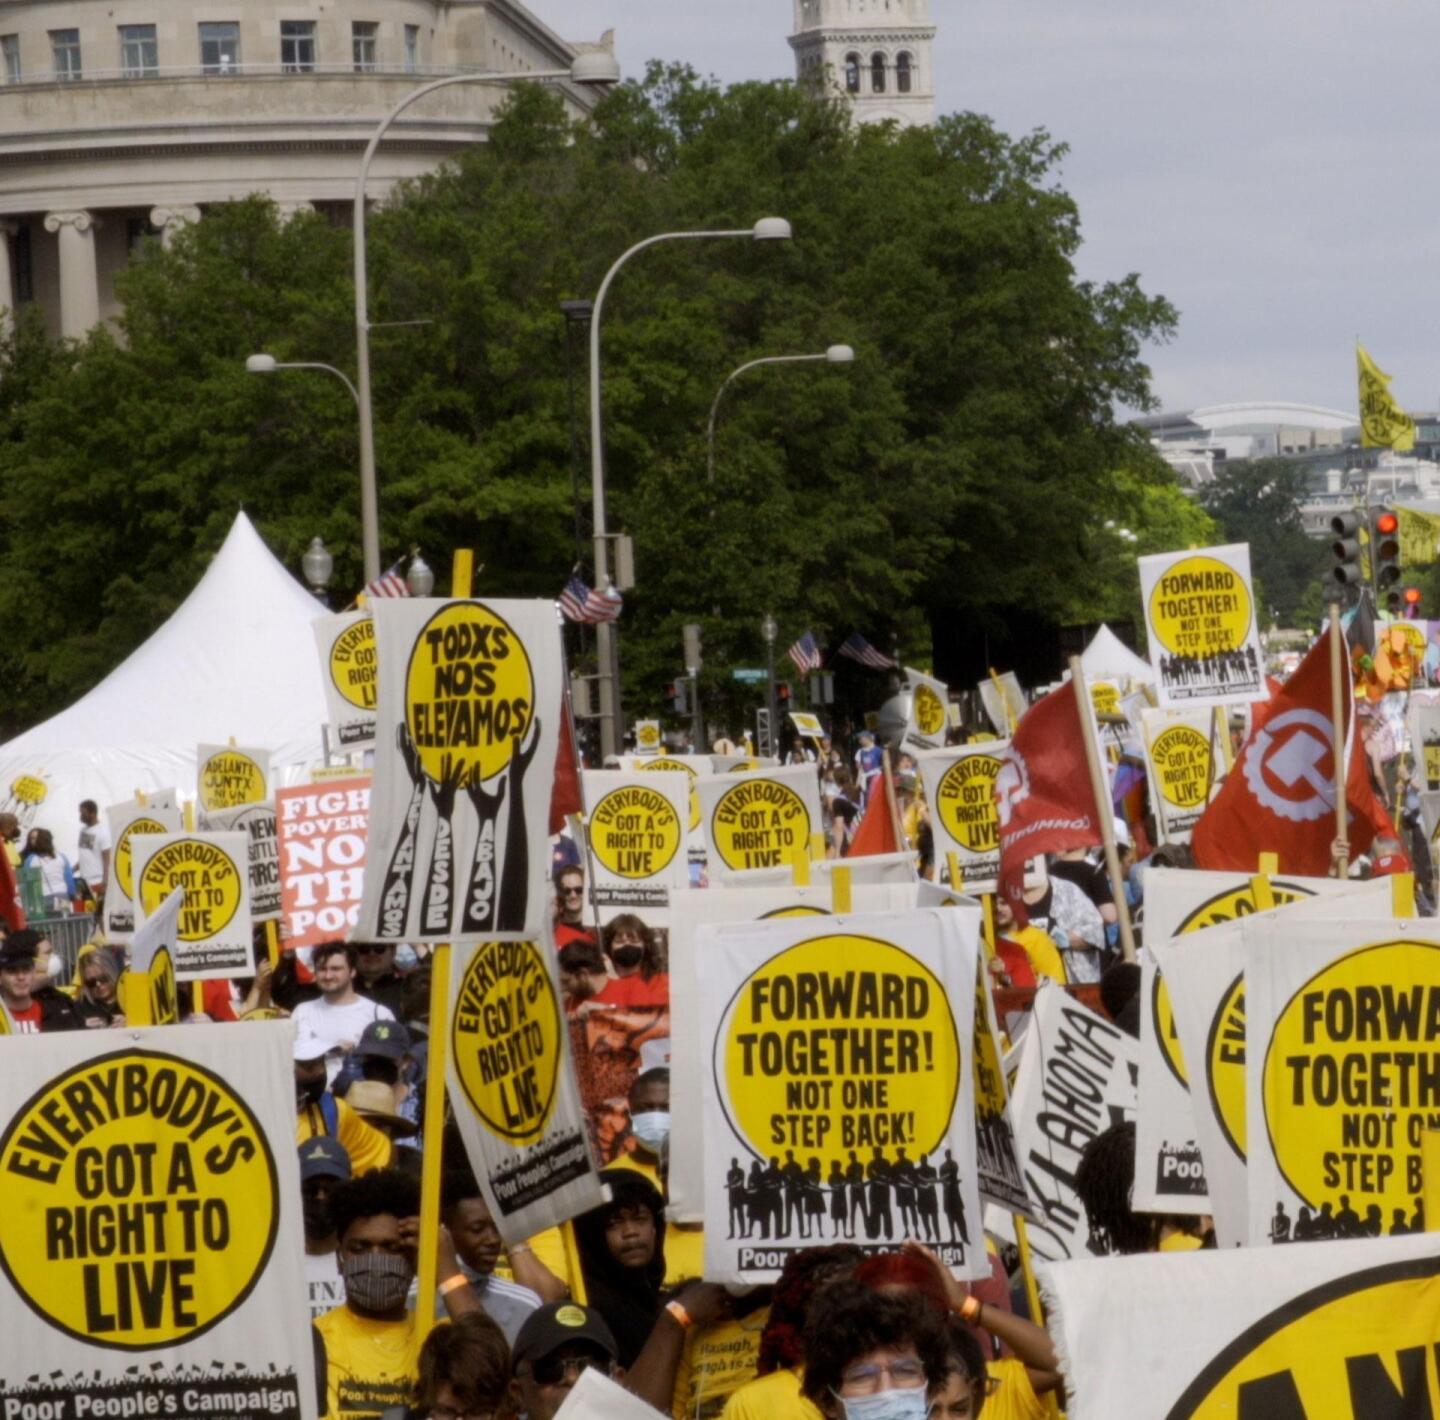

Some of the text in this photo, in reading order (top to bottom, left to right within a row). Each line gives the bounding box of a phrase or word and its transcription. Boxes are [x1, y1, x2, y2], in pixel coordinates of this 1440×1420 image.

[1162, 571, 1233, 596] FORWARD
[1159, 595, 1237, 618] TOGETHER!
[1176, 630, 1233, 646] STEP BACK!
[1180, 617, 1222, 632] NOT ONE
[426, 622, 509, 664] TODXS
[434, 662, 496, 699] NOS
[1170, 688, 1187, 699] Poor
[413, 698, 529, 748] ELEVAMOS
[1154, 730, 1208, 765] EVERYBODY'S
[1168, 750, 1196, 767] GOT A
[1164, 765, 1206, 784] RIGHT TO
[1174, 781, 1200, 802] LIVE
[596, 789, 673, 828] EVERYBODY'S
[717, 780, 802, 825] EVERYBODY'S
[963, 785, 985, 804] GOT
[616, 814, 654, 832] GOT A
[741, 812, 781, 831] GOT A
[956, 803, 989, 823] RIGHT
[606, 832, 664, 849] RIGHT TO
[732, 828, 794, 850] RIGHT TO
[146, 842, 232, 884] EVERYBODY'S
[169, 870, 212, 888] GOT A
[426, 816, 451, 928] DESDE
[469, 818, 494, 921] ABAJO
[616, 851, 652, 873] LIVE
[208, 888, 223, 905] TO
[458, 942, 544, 1034] EVERYBODY'S
[515, 987, 527, 1022] A
[751, 970, 930, 1024] FORWARD
[478, 1020, 544, 1086] RIGHT TO
[736, 1028, 934, 1077] TOGETHER!
[499, 1066, 543, 1129] LIVE
[785, 1079, 888, 1111] NOT ONE
[7, 1064, 255, 1185] EVERYBODY'S
[770, 1112, 915, 1149] STEP BACK!
[1342, 1113, 1397, 1149] NOT
[75, 1142, 197, 1199] GOT A
[1323, 1151, 1394, 1195] STEP
[46, 1198, 230, 1260] RIGHT TO
[742, 1248, 787, 1268] Poor
[82, 1259, 198, 1333] LIVE
[5, 1388, 297, 1420] Poor People's Campaign
